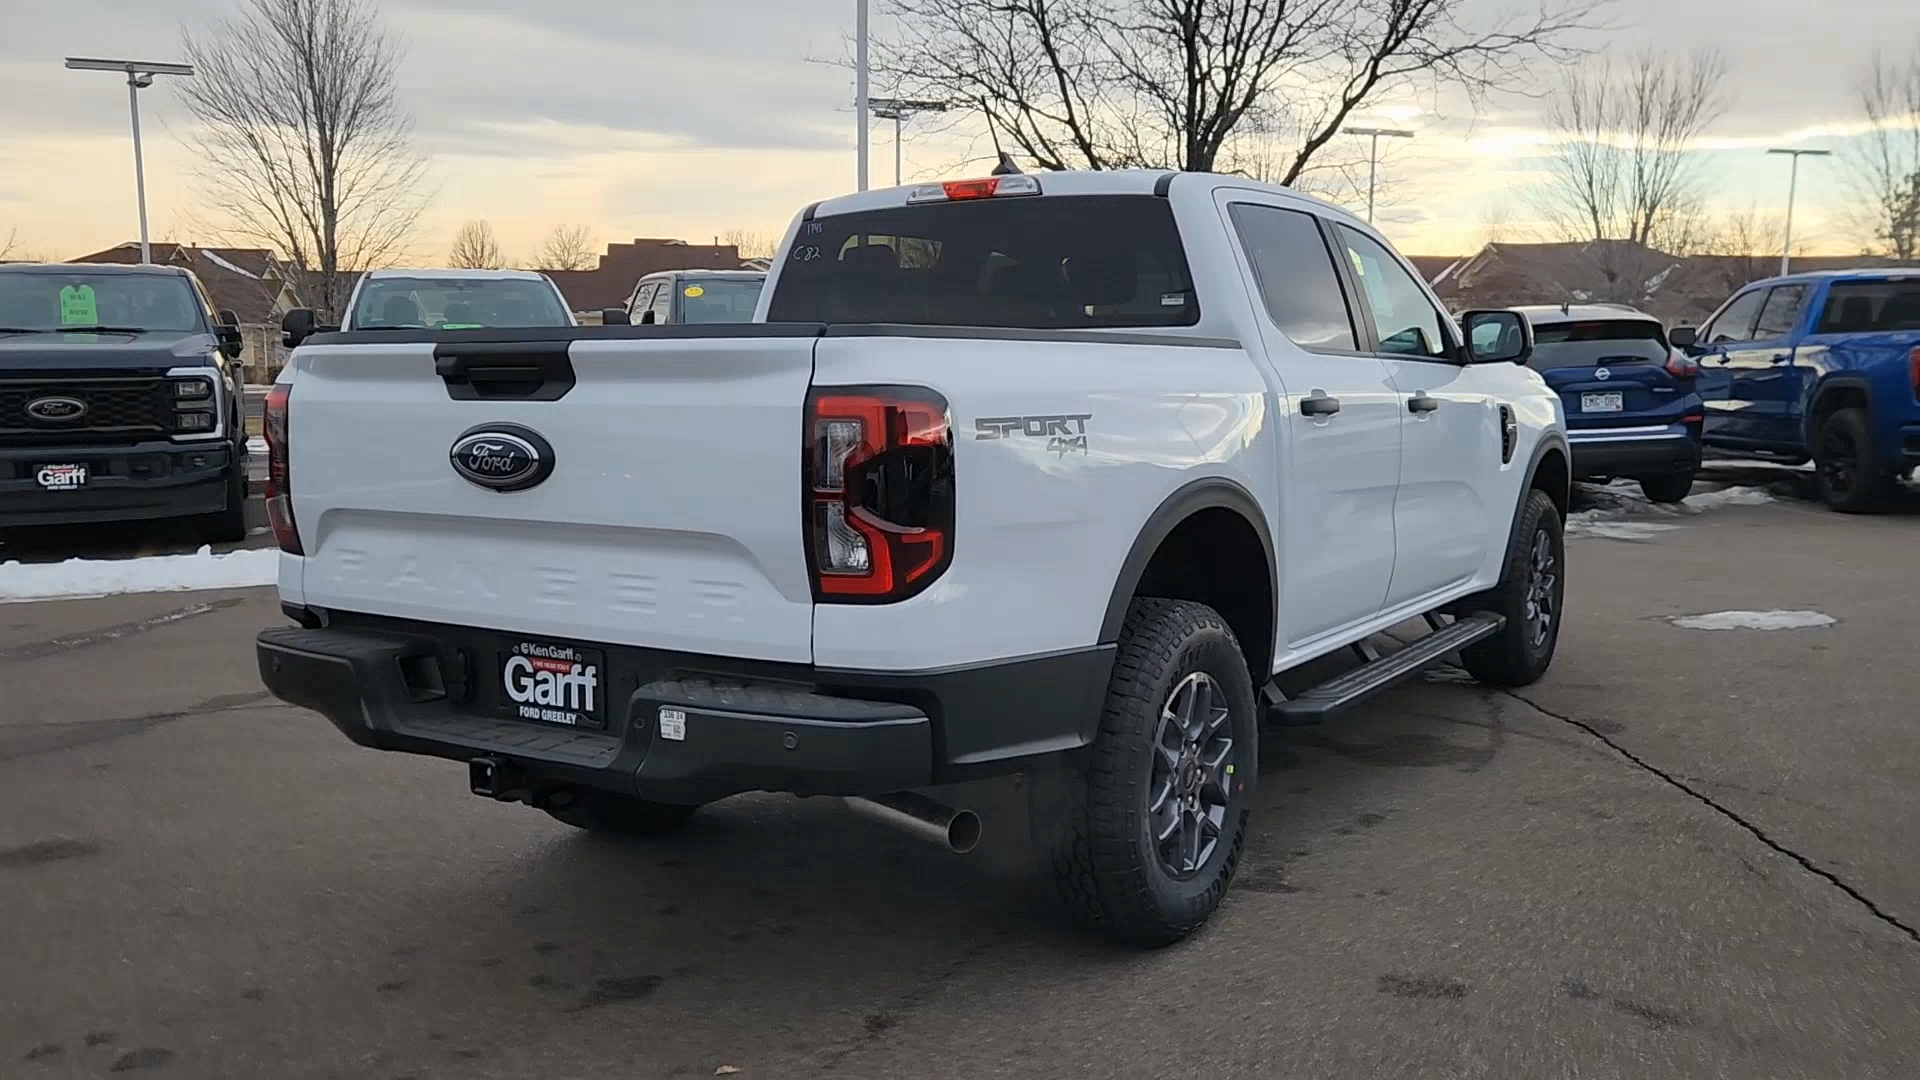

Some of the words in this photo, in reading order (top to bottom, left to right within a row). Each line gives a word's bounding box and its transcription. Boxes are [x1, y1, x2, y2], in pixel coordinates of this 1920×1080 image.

[974, 413, 1094, 441] SPORT
[468, 442, 515, 472] Ford
[37, 468, 86, 486] Garff
[528, 642, 549, 657] Ken
[548, 645, 574, 660] Garff
[503, 655, 598, 712] Garff
[519, 705, 541, 719] FORD
[540, 708, 578, 725] GREELEY
